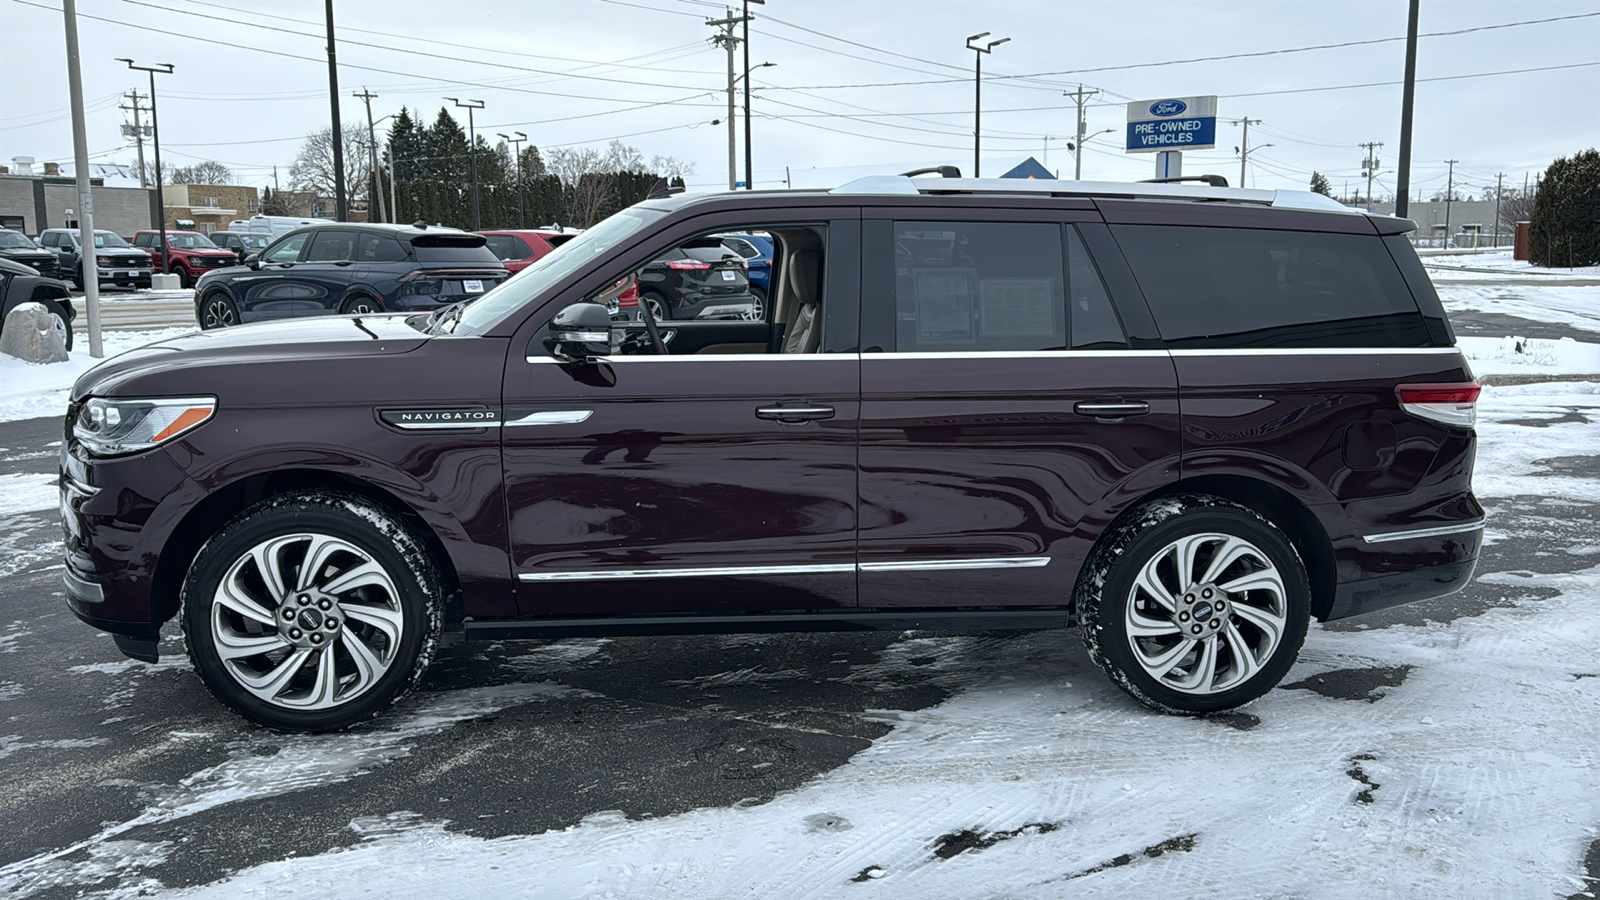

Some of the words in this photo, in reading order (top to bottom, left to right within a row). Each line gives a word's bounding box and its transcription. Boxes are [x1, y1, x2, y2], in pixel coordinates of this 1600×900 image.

[1156, 102, 1178, 114] Ford
[1135, 120, 1202, 134] PRE-OWNED
[1141, 132, 1193, 145] VEHICLES
[402, 412, 495, 420] NAVIGATOR
